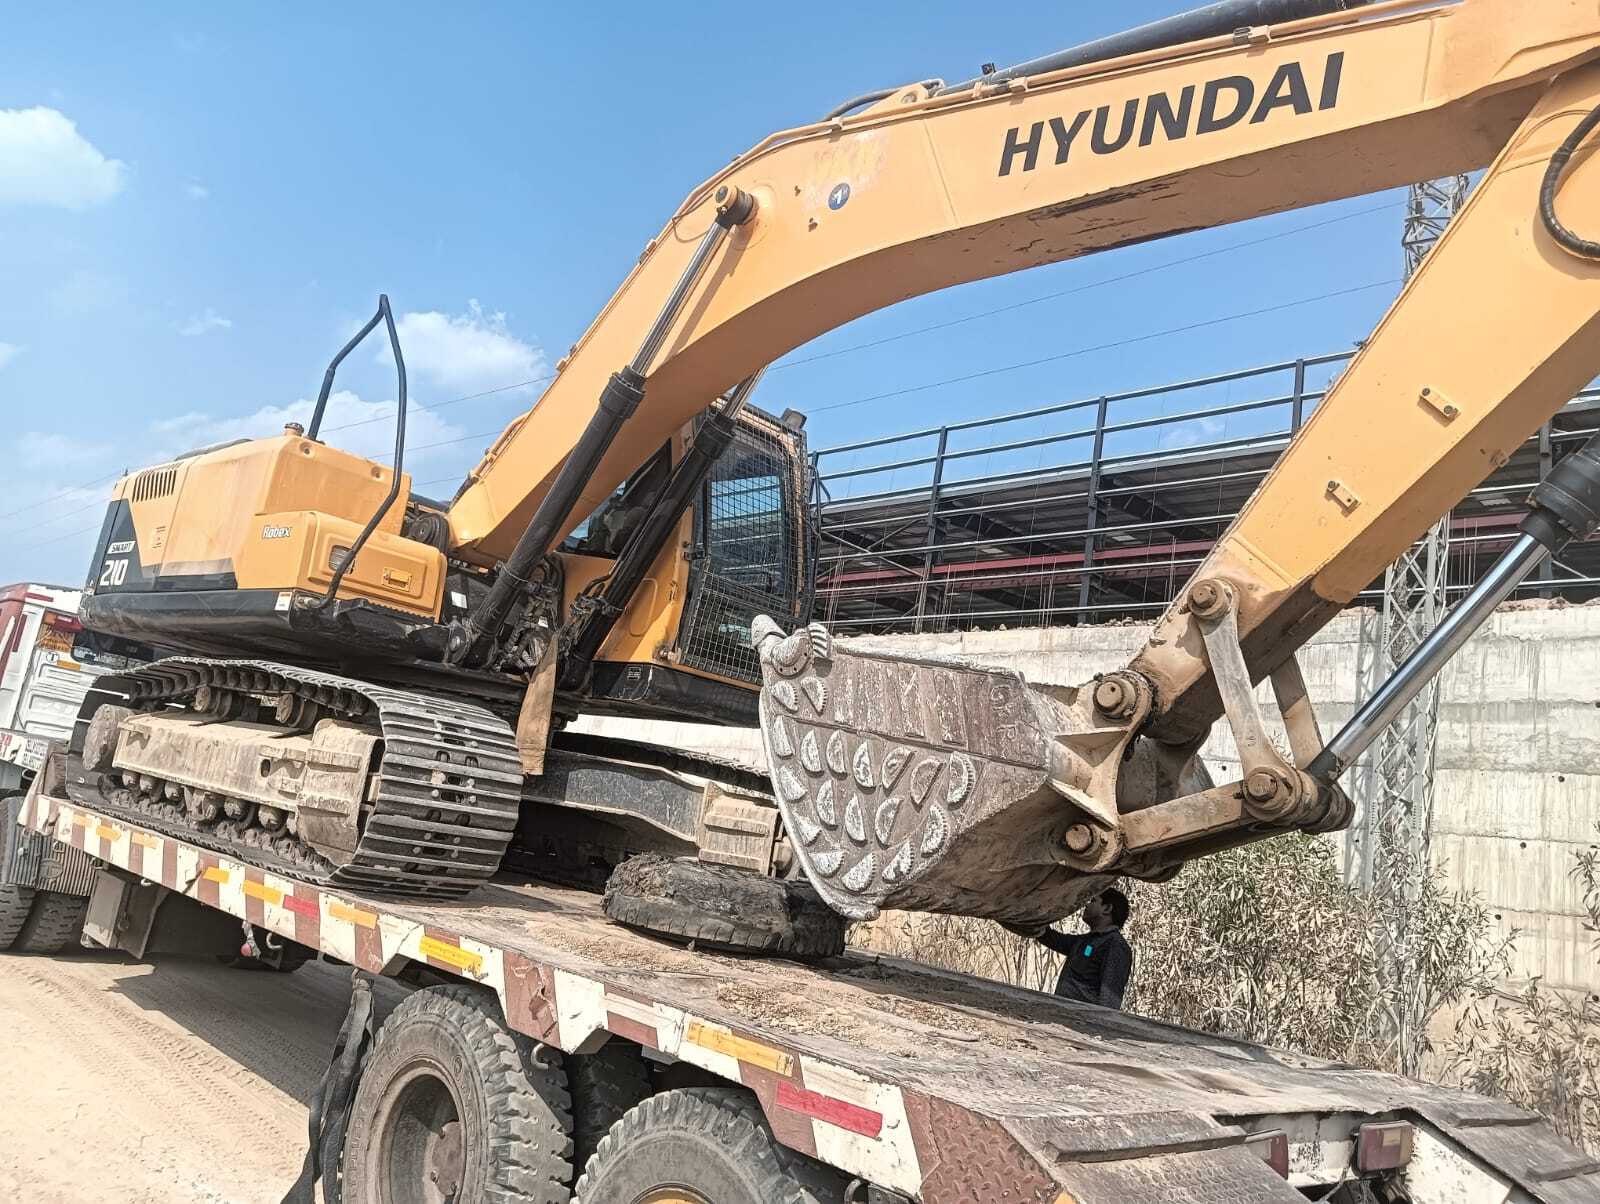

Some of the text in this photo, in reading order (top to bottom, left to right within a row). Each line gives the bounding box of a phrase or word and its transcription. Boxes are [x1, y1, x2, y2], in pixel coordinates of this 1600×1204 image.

[998, 51, 1345, 177] HYUNDAI
[262, 525, 292, 539] Robex
[99, 559, 129, 586] 210
